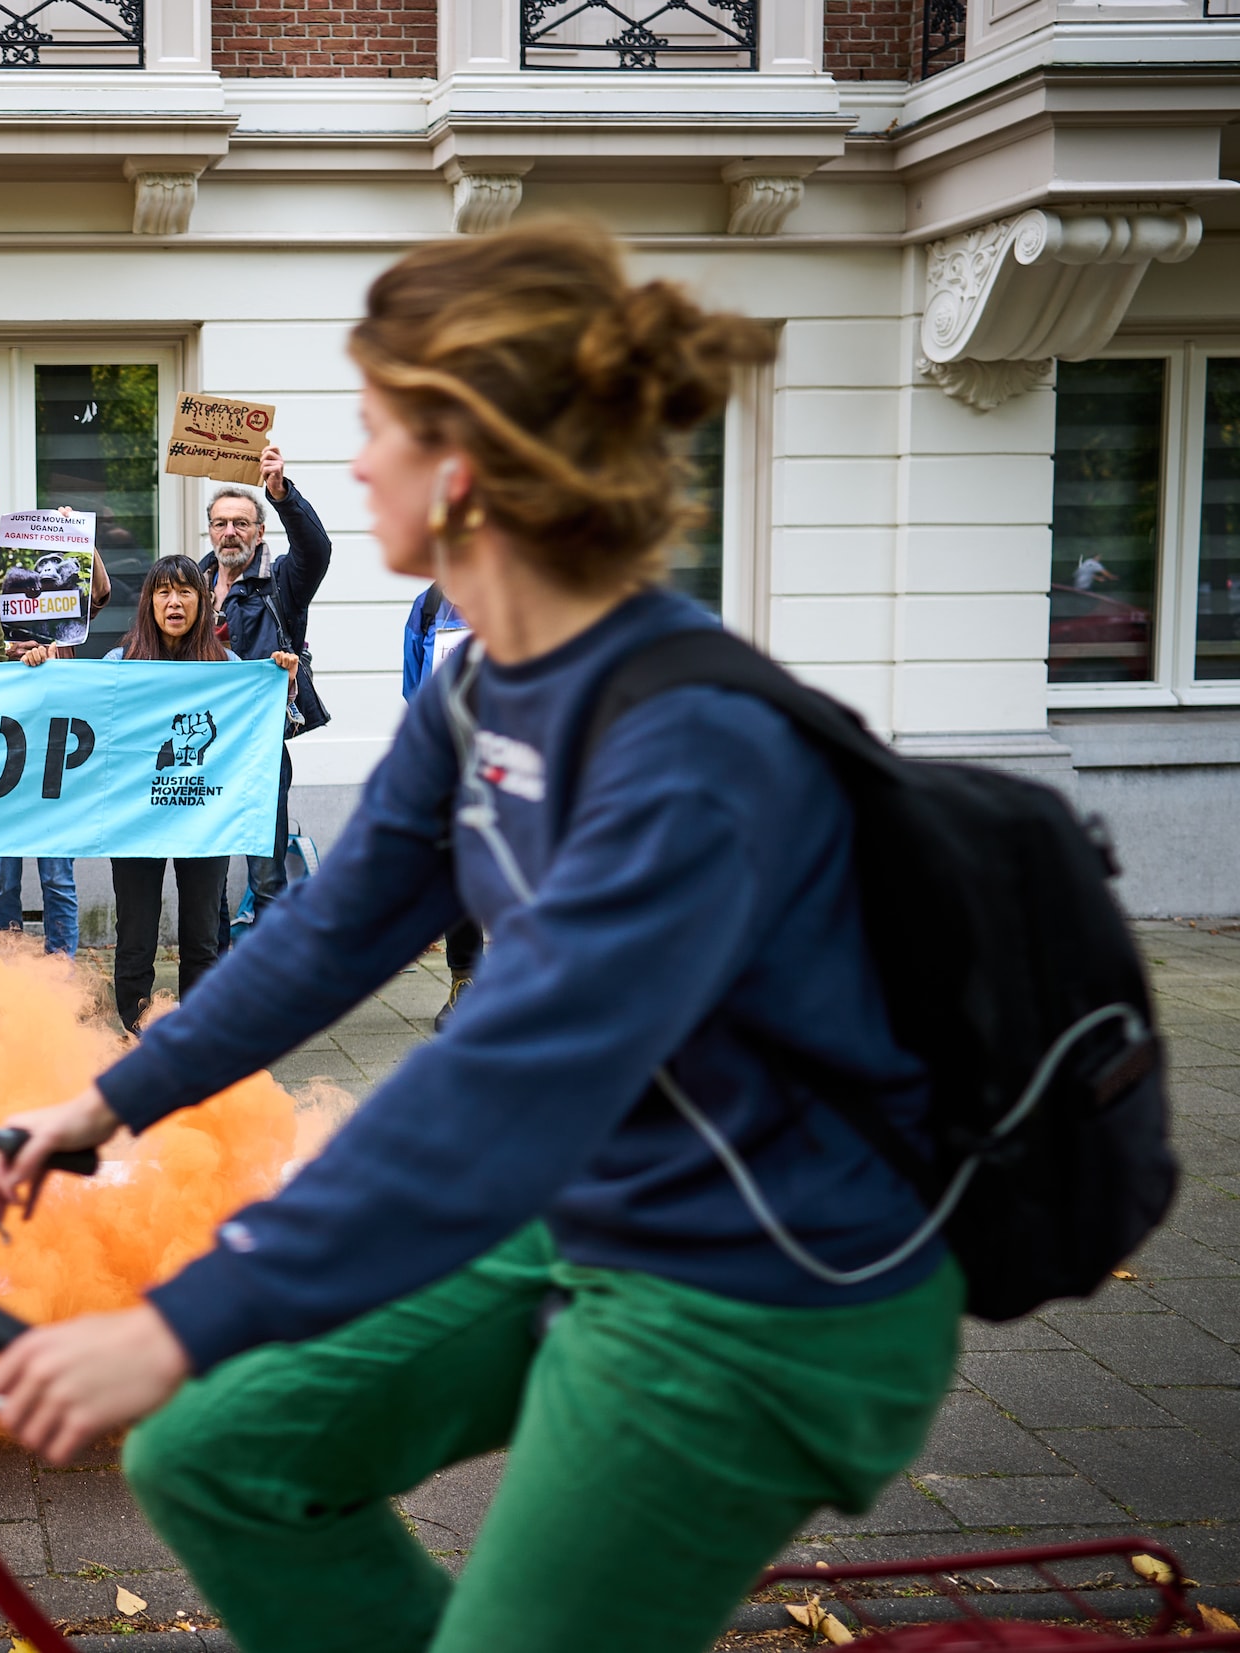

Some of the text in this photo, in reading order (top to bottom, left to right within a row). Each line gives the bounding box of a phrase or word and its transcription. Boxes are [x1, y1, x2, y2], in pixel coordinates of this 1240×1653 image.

[10, 515, 86, 525] JUSTICE MOVEMENT
[30, 524, 64, 533] UGANDA
[4, 532, 89, 544] AGAINST FOSSIL FUELS
[2, 596, 77, 615] #STOPEACOP
[151, 776, 205, 786] JUSTICE
[151, 786, 224, 796] MOVEMENT
[150, 796, 206, 806] UGANDA
